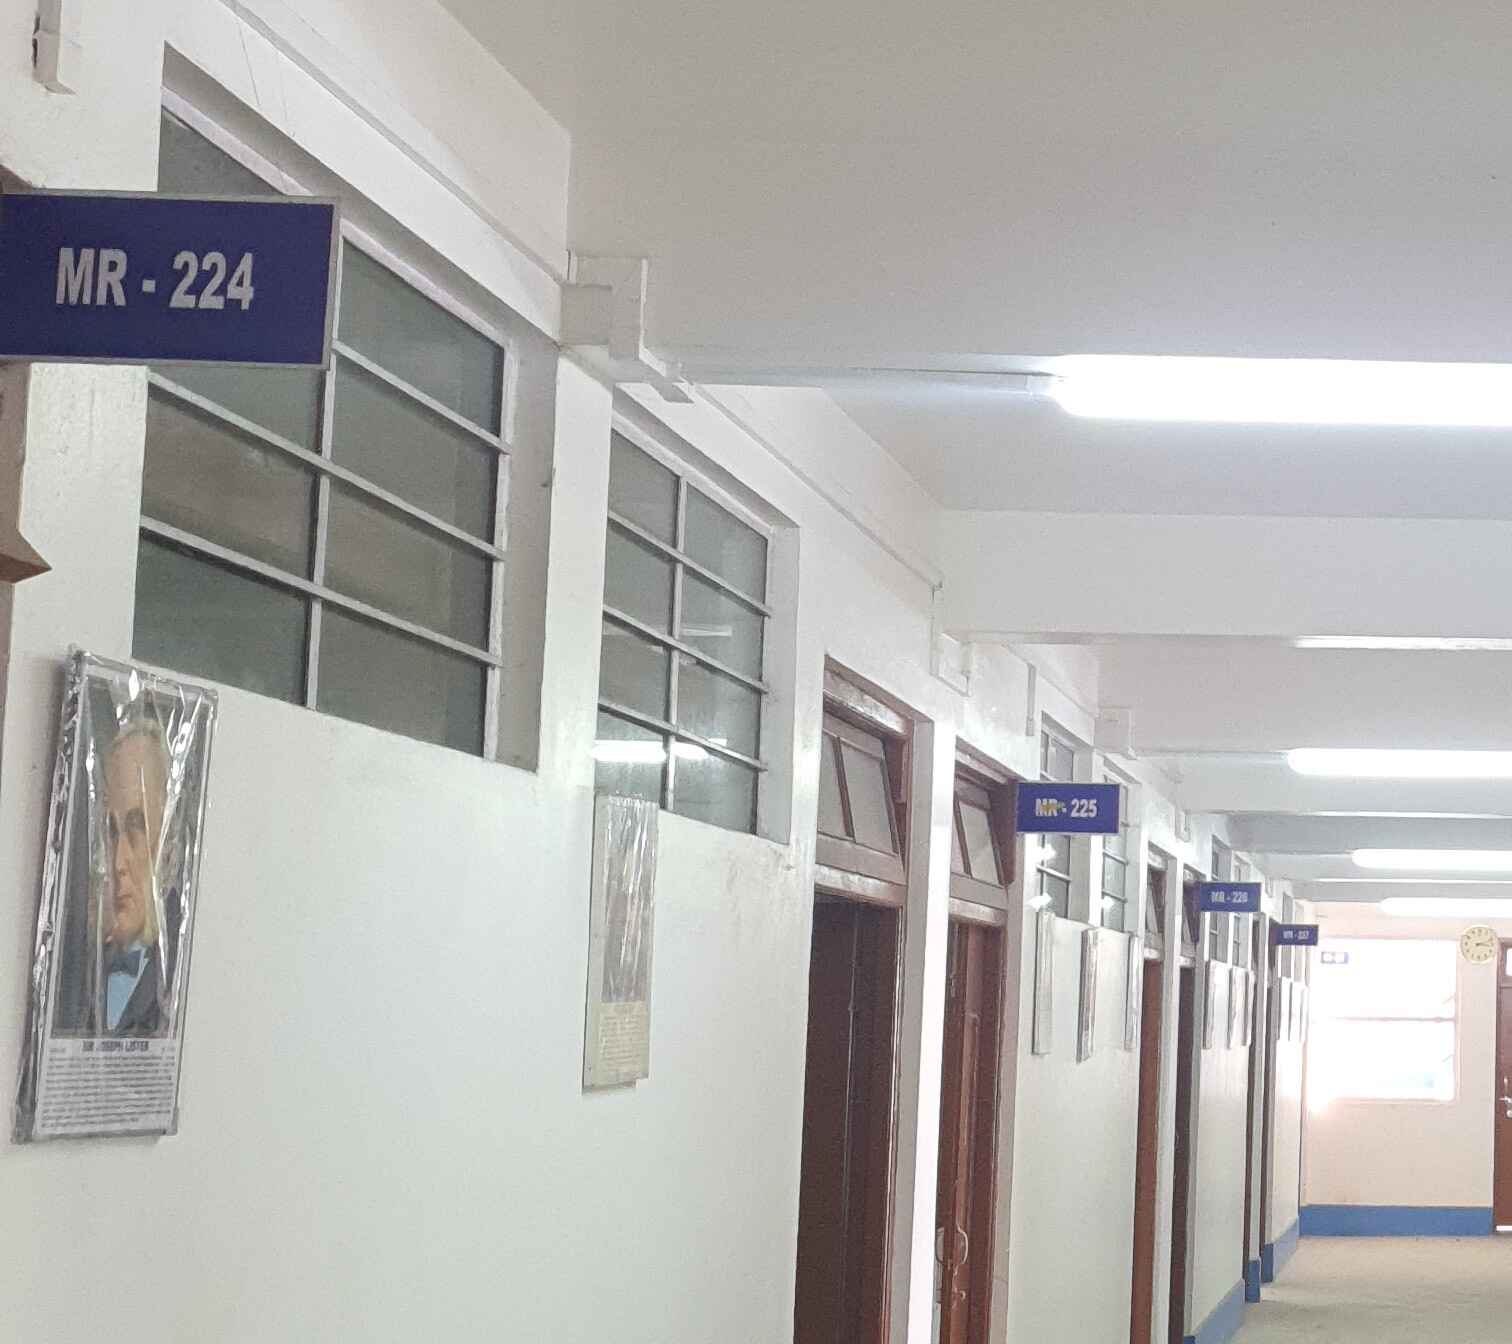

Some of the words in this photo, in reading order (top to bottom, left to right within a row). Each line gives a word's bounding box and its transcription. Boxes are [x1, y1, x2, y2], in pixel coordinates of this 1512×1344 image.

[56, 247, 128, 306] MR
[169, 250, 254, 310] 224
[1035, 798, 1057, 817] MR
[1071, 798, 1097, 818] 225
